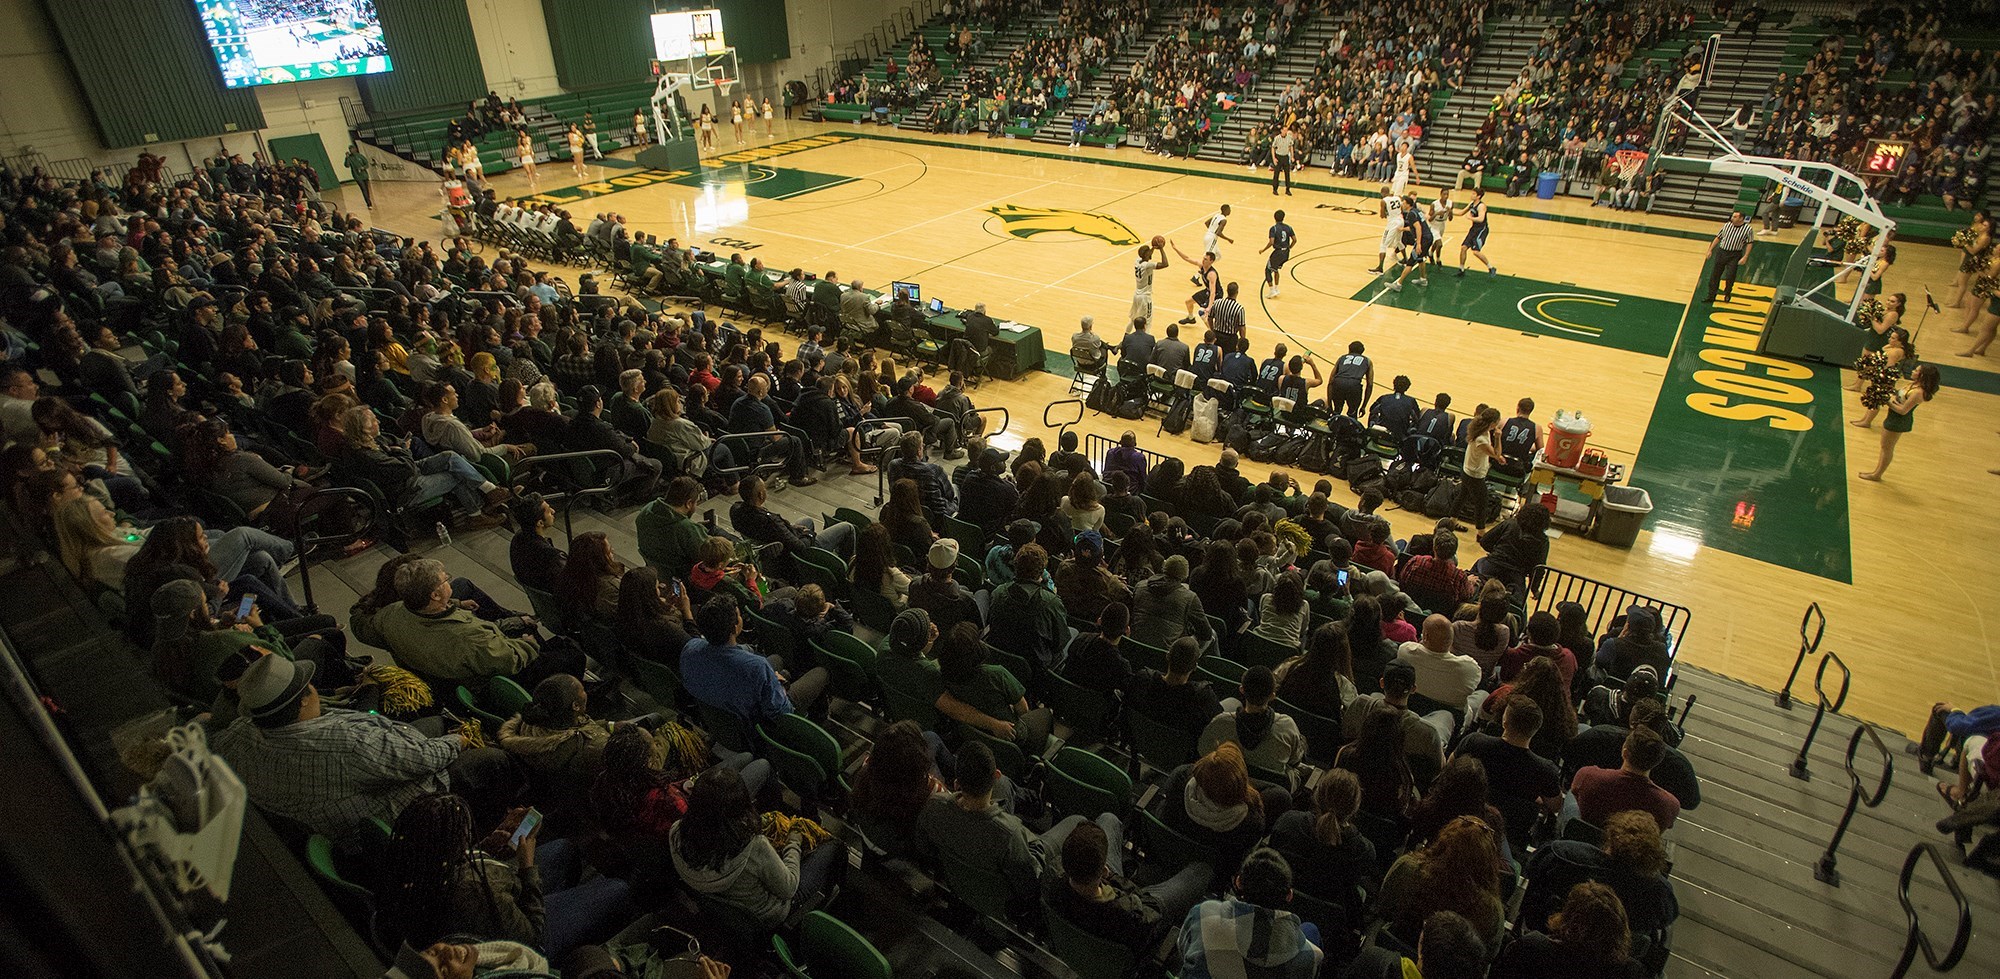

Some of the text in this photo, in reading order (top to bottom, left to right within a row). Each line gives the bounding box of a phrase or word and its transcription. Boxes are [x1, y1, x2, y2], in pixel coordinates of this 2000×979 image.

[1782, 176, 1814, 194] Schelde
[1390, 200, 1401, 210] 23
[1195, 348, 1213, 363] 32
[1343, 355, 1364, 366] 20
[1261, 364, 1278, 381] 42
[1507, 425, 1530, 445] 34
[1559, 439, 1572, 450] G
